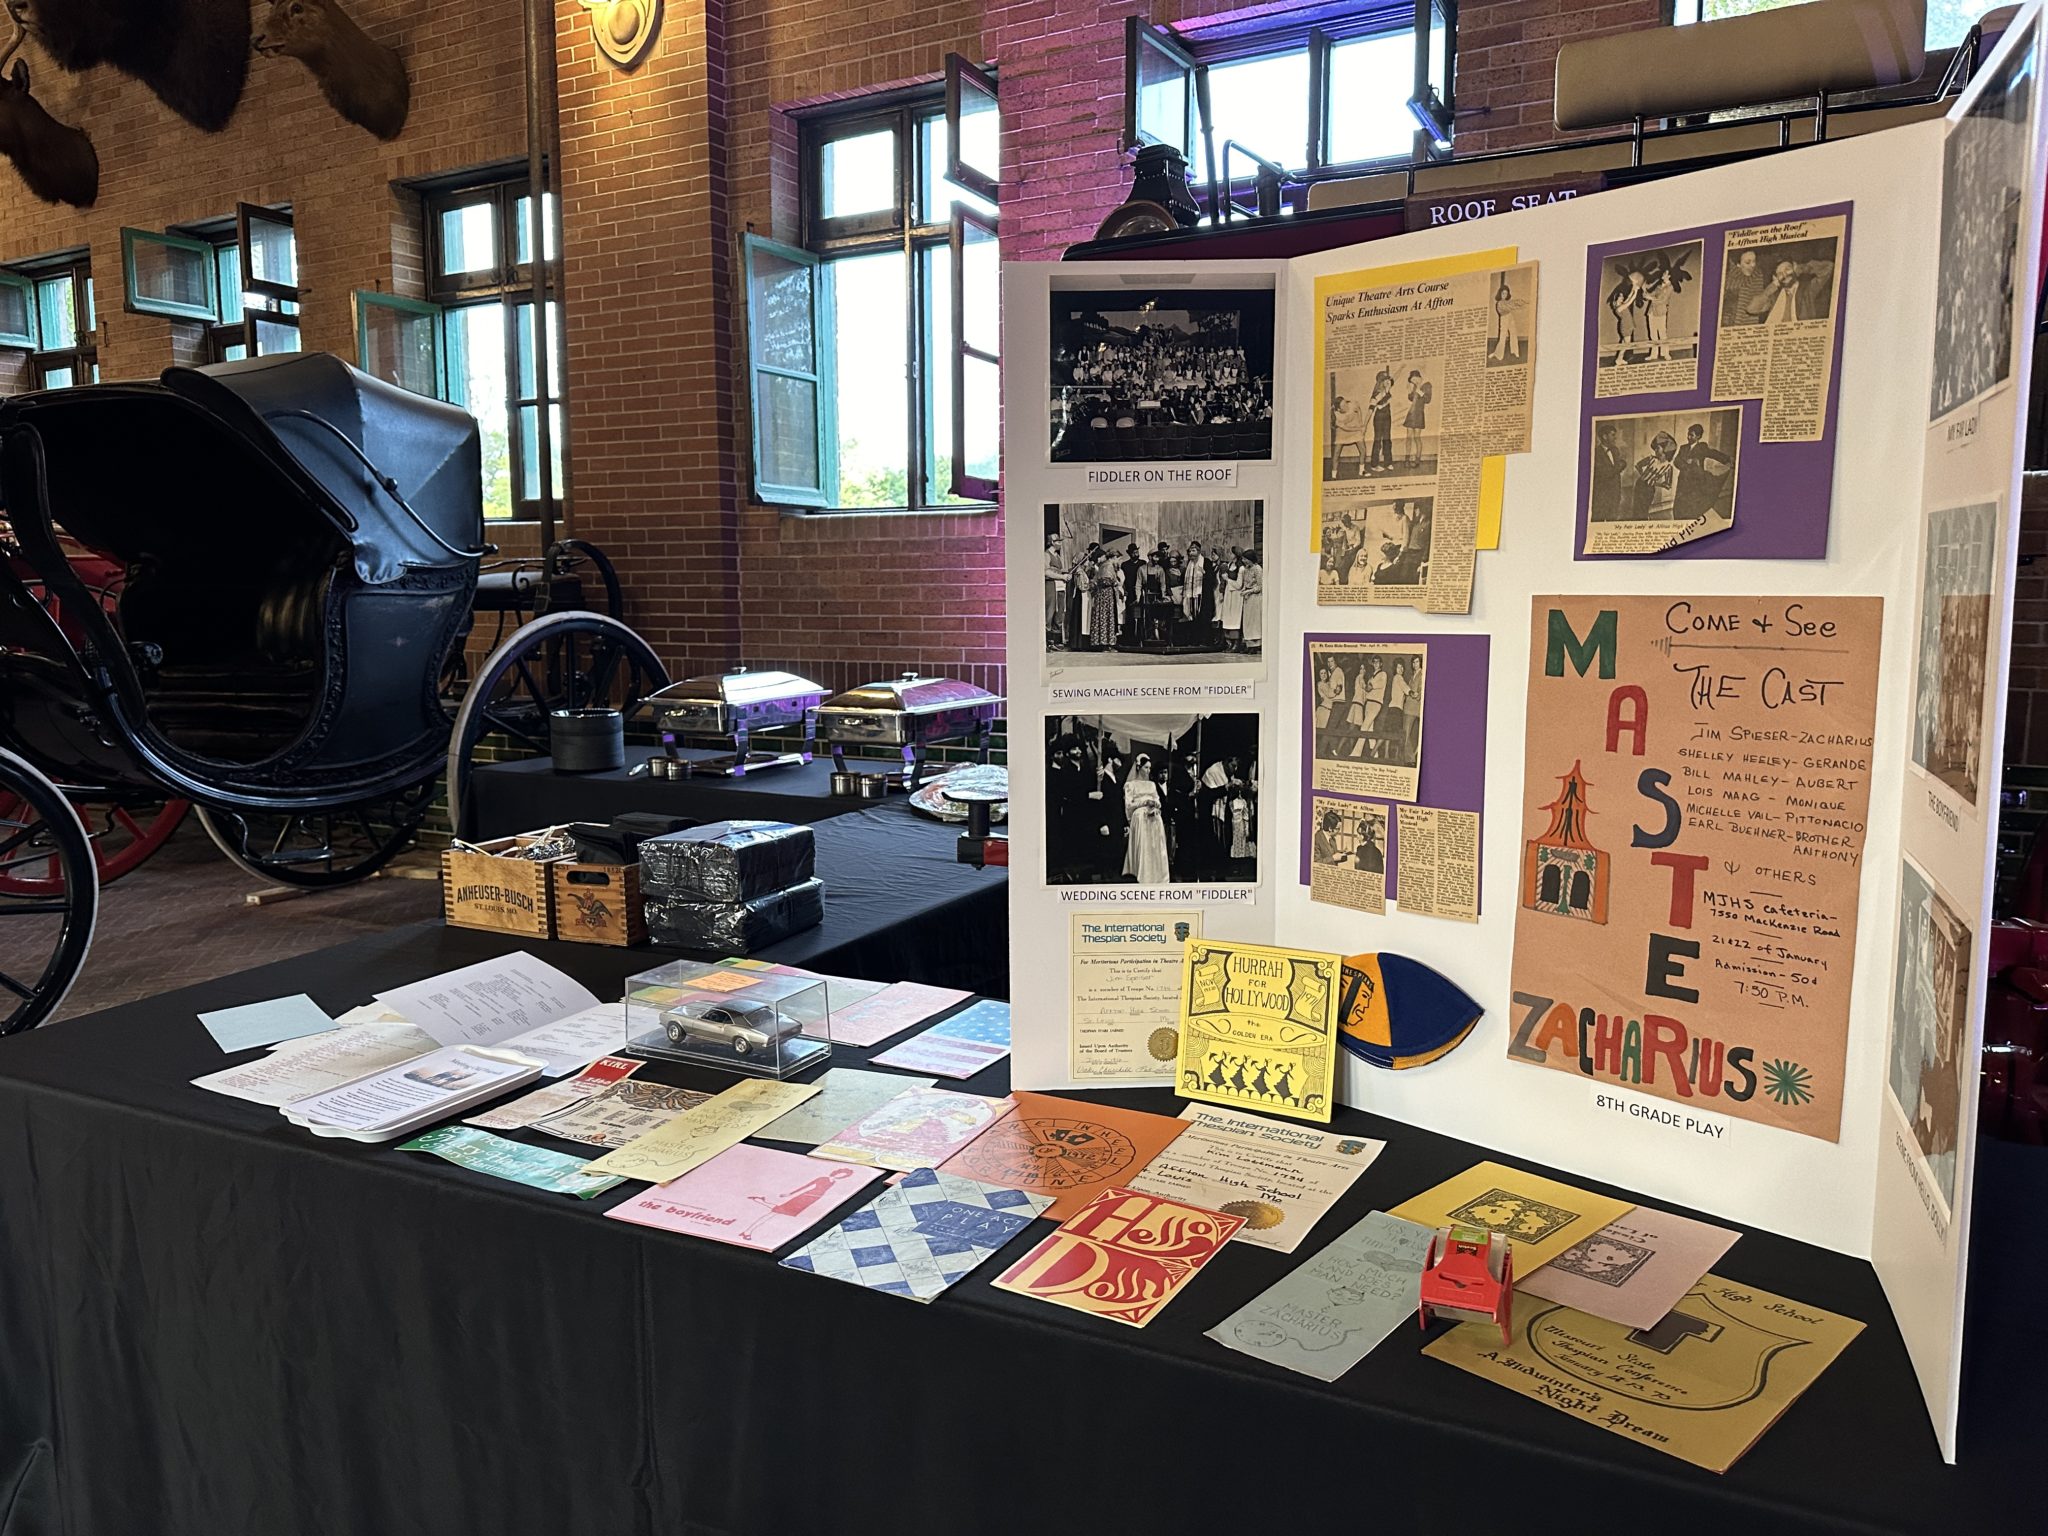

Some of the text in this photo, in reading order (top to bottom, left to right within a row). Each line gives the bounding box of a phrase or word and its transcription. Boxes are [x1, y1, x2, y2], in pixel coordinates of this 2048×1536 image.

[1430, 199, 1496, 225] ROOF
[1760, 235, 1777, 244] High
[1779, 231, 1808, 240] Musical
[1326, 281, 1449, 307] Unique Theatre Arts Course
[1326, 297, 1453, 324] Sparks Enthusiasm At Affton
[1088, 468, 1232, 483] FIDDLER ON THE ROOF
[1052, 685, 1252, 699] SEWING MACHINE SCENE FROM "FIDDLER"
[1673, 663, 1844, 710] THE CAST
[1677, 748, 1734, 762] SHELLEY
[1682, 766, 1710, 780] BILL
[1795, 776, 1859, 791] AUBERT
[1688, 786, 1846, 811] LOIS MAAG MONIQUE
[1686, 803, 1741, 819] MICHELLE
[1785, 811, 1864, 833] PITTONACIO
[1688, 817, 1724, 832] EARL
[1793, 845, 1859, 867] ANTHONY
[1755, 866, 1816, 886] OTHERS
[457, 885, 534, 913] ANHEUSER-BUSCH
[1061, 889, 1253, 901] WEDDING SCENE FROM "FIDDLER"
[1703, 890, 1755, 910] MJHS
[1082, 924, 1165, 933] The International
[1082, 934, 1166, 944] Thespian Society
[1813, 926, 1841, 938] Road
[1233, 956, 1284, 978] HURRAH
[1757, 941, 1772, 955] of
[1775, 946, 1828, 971] January
[1248, 979, 1267, 988] FOR
[1225, 987, 1290, 1012] HOLLYWOOD
[1775, 990, 1809, 1008] P.M.
[1232, 1030, 1256, 1039] GOLDEN
[1506, 990, 1758, 1102] ZACHARIUS
[1197, 1112, 1324, 1142] The International
[1596, 1094, 1724, 1139] 8TH GRADE PLAY
[1191, 1119, 1322, 1149] Thespian Society
[1067, 1151, 1097, 1161] 1972
[1157, 1170, 1192, 1182] Louis
[1158, 1163, 1302, 1199] Affton High School
[638, 1201, 662, 1210] the
[665, 1206, 736, 1226] boyfriend
[941, 1213, 1014, 1234] PLAY
[952, 1207, 1021, 1226] ONE ACT
[1072, 1196, 1213, 1247] Hello
[1010, 1233, 1172, 1304] Dolly
[1310, 1267, 1343, 1283] MAN
[1318, 1261, 1353, 1277] LAND
[1358, 1272, 1390, 1288] DOES
[1366, 1267, 1408, 1285] MUCH
[1282, 1302, 1343, 1329] MASTER
[1713, 1288, 1825, 1325] High School
[1259, 1305, 1342, 1340] ZACHARIUS
[1477, 1351, 1497, 1361] A
[1544, 1325, 1655, 1370] Missouri State
[1551, 1340, 1688, 1396] Thespian Conference
[1554, 1353, 1603, 1377] January
[1530, 1384, 1670, 1443] Night Dream
